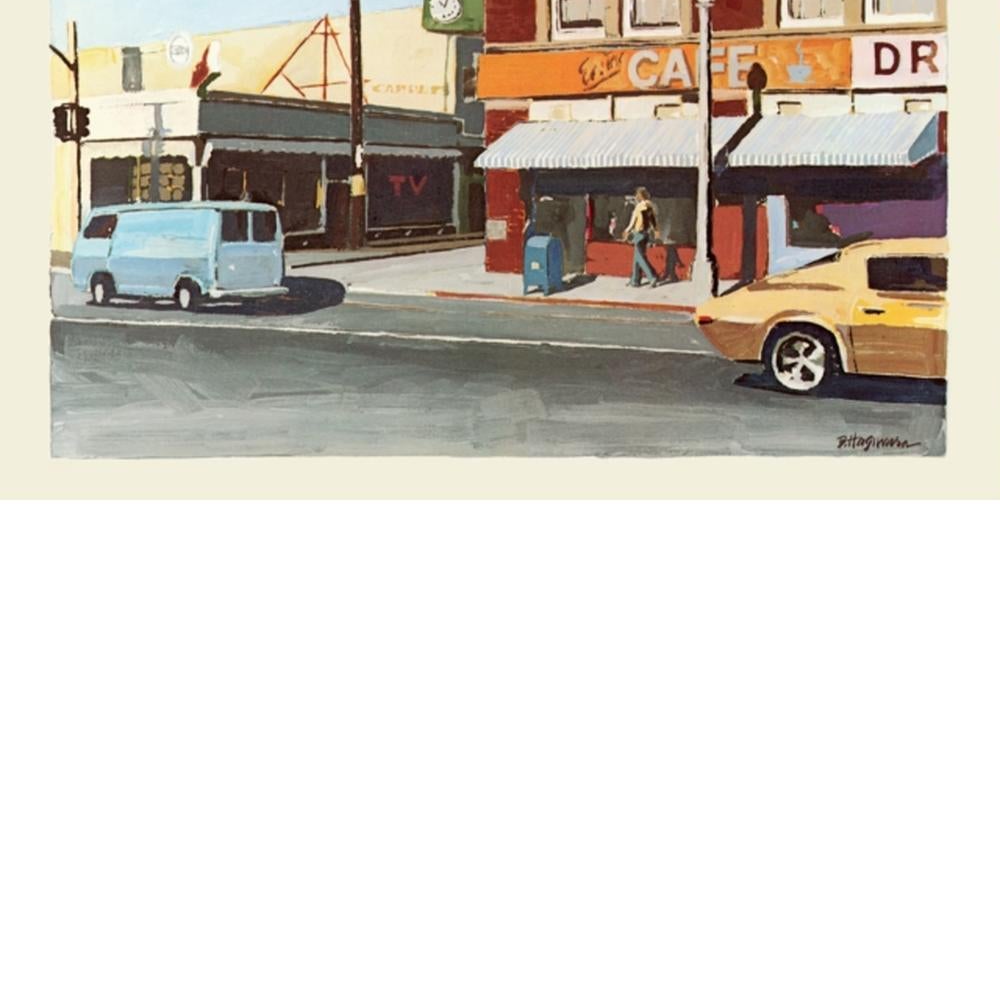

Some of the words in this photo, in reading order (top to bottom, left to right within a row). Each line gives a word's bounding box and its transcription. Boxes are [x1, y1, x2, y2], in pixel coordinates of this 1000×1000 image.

[627, 44, 756, 91] CAFE
[873, 40, 939, 75] DR
[388, 174, 428, 197] TV
